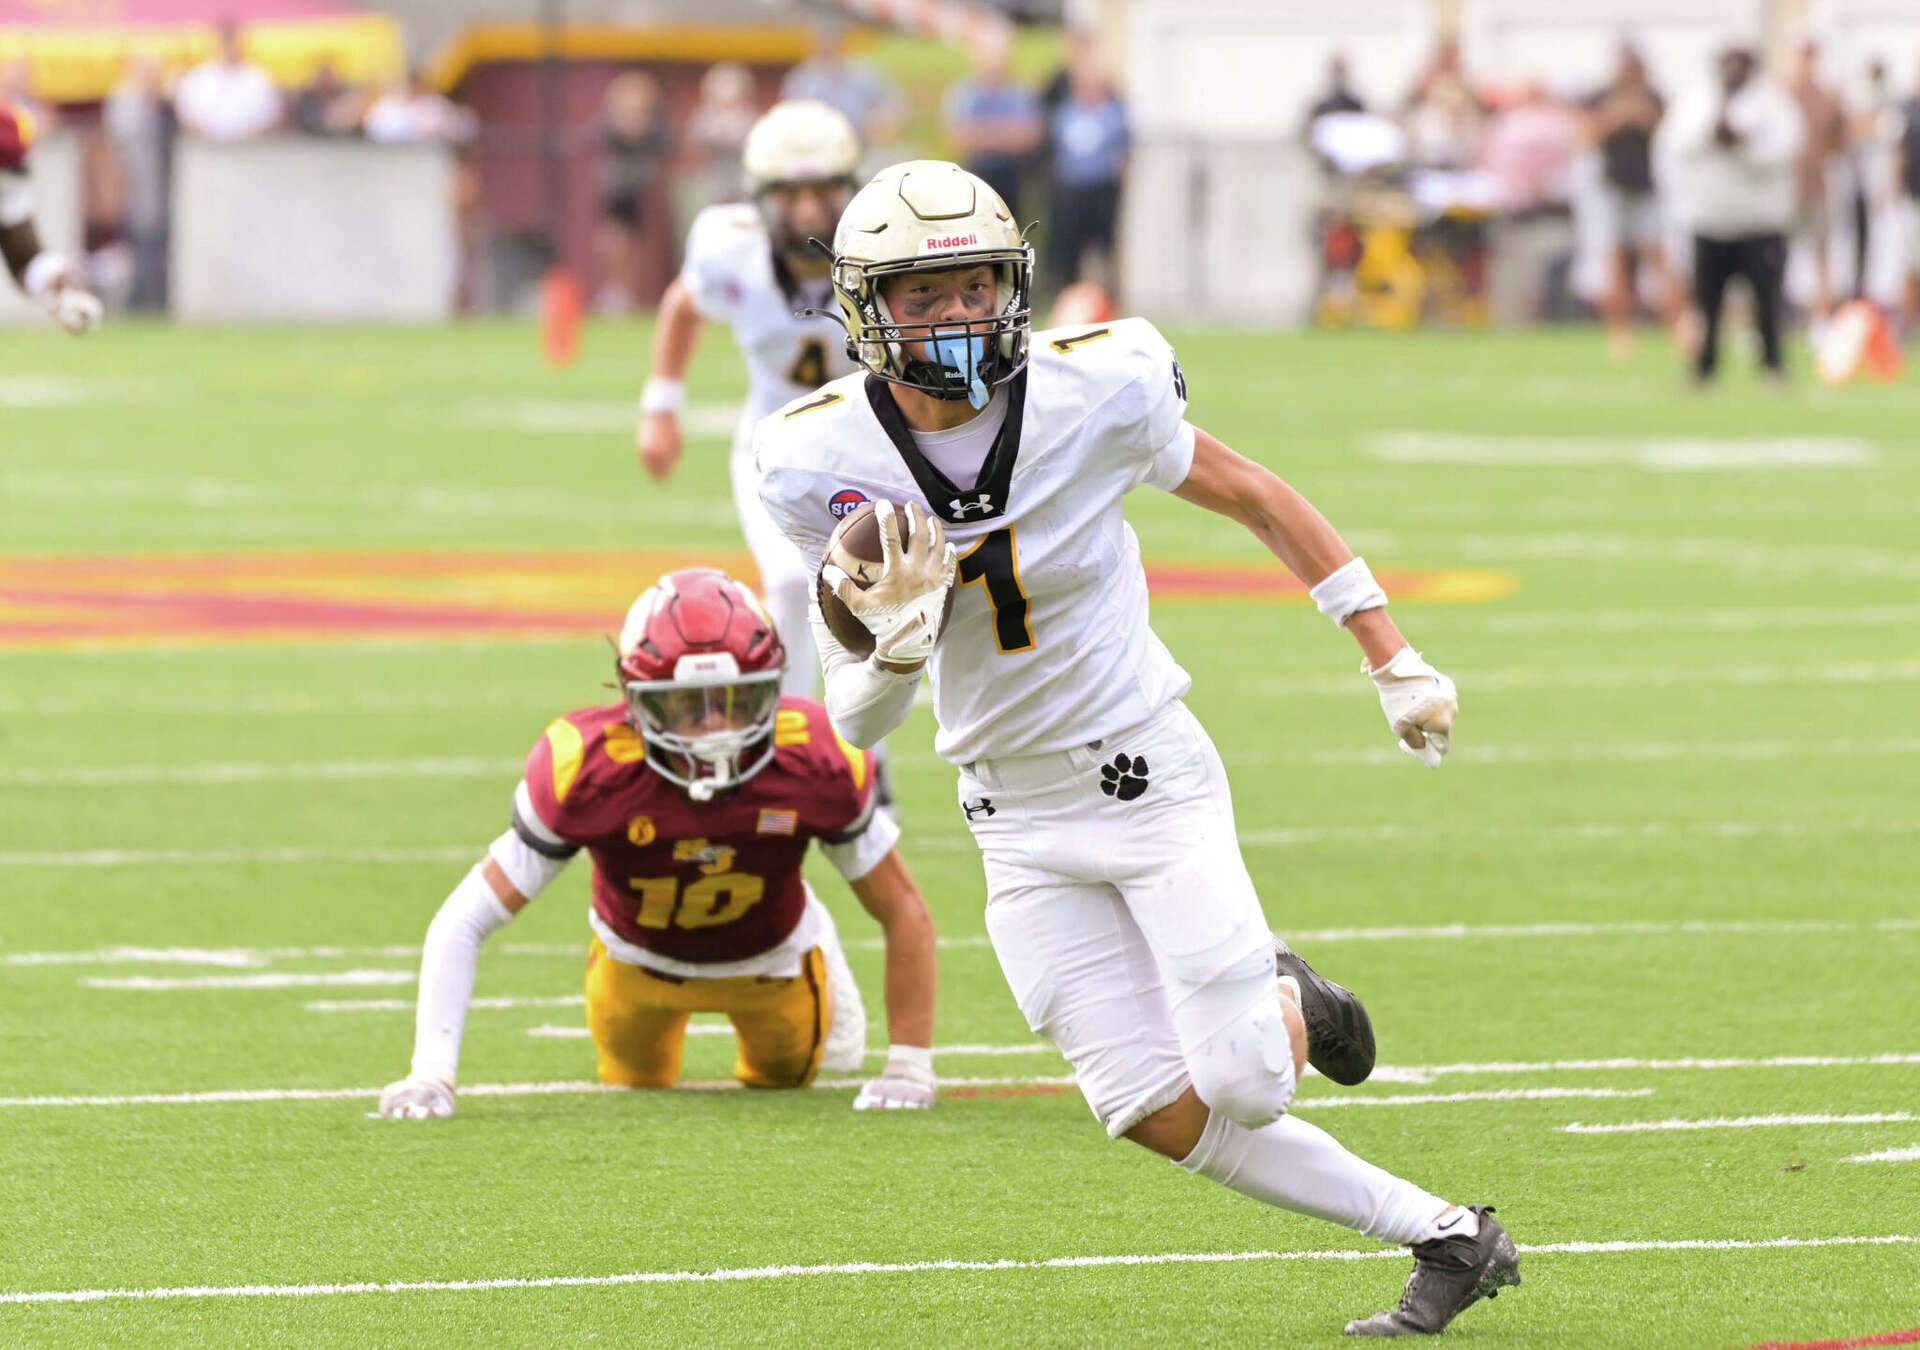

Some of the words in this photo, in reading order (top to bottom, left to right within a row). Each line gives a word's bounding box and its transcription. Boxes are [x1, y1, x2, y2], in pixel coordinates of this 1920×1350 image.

[927, 233, 977, 249] Riddell
[1049, 327, 1112, 355] 1
[784, 392, 844, 422] 1
[830, 501, 870, 517] SC
[956, 523, 1038, 655] 1
[629, 872, 765, 930] 10
